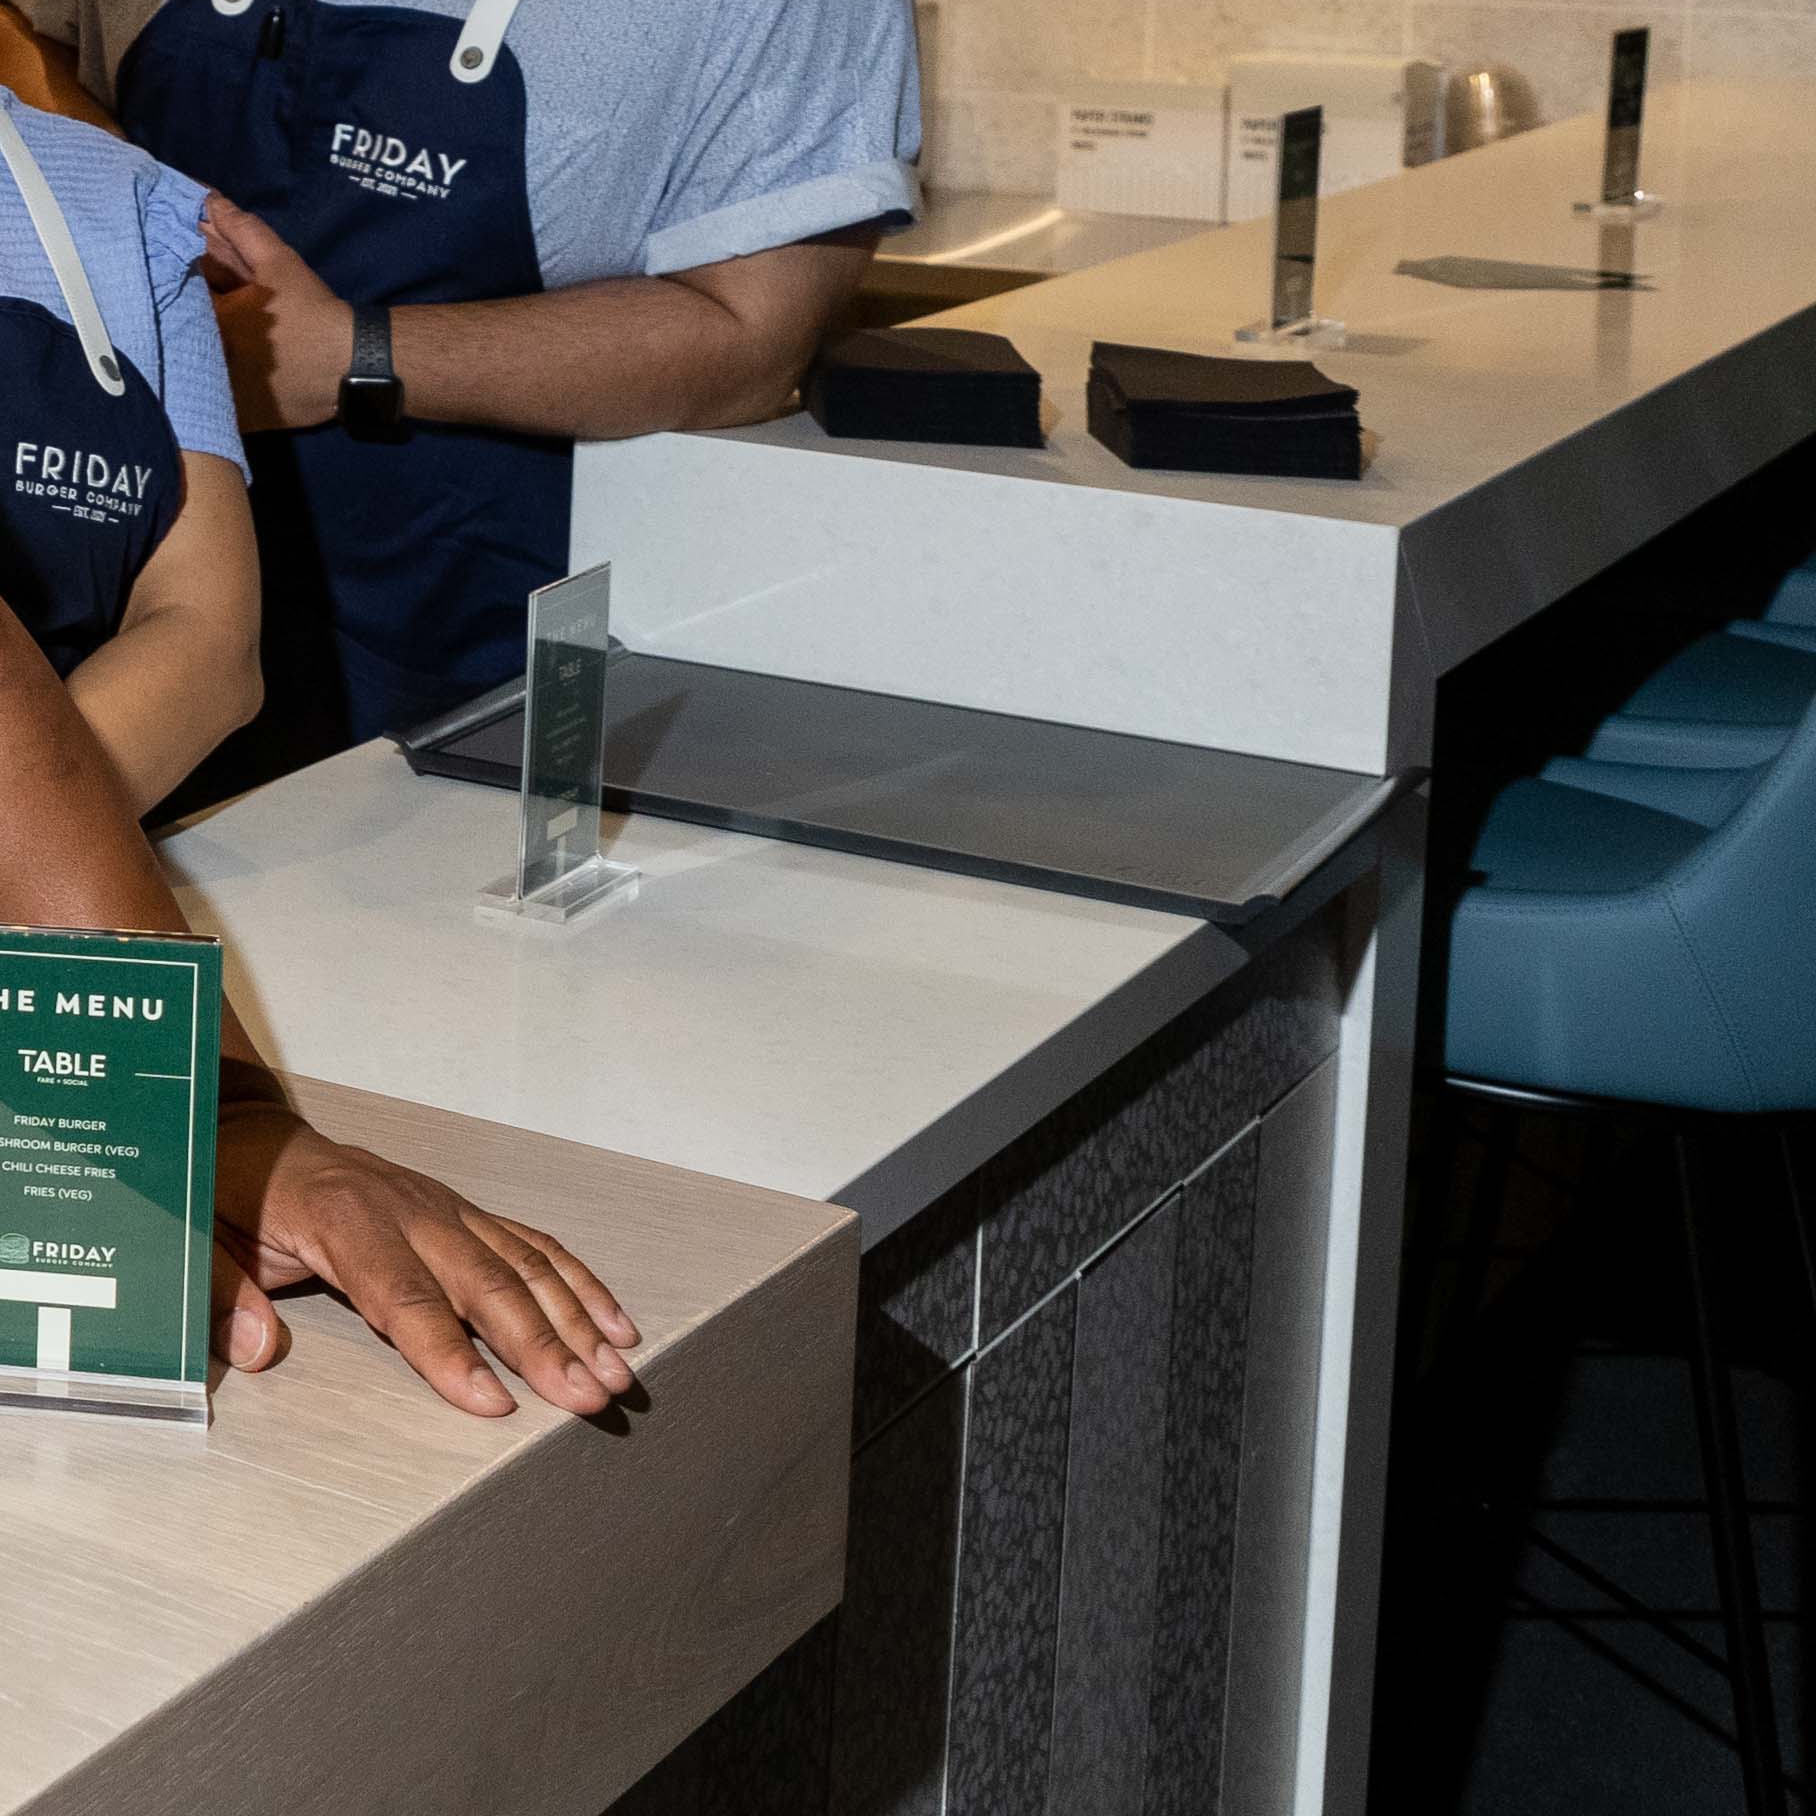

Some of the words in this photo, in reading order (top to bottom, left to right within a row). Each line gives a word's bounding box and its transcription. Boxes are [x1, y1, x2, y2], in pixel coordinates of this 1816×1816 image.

[331, 123, 467, 185] FRIDAY
[375, 167, 451, 199] COMPANY
[16, 442, 152, 499] FRIDAY
[15, 480, 78, 500] BURGER
[86, 491, 143, 516] COMPANY
[56, 992, 164, 1021] MENU
[18, 1049, 106, 1077] TABLE
[14, 1115, 56, 1127] FRIDAY
[58, 1118, 106, 1131] BURGER
[54, 1141, 101, 1154] BURGER
[105, 1145, 139, 1158] (VEG)
[2, 1161, 33, 1172] CHILI
[35, 1163, 81, 1176] CHEESE
[84, 1167, 116, 1179] FRIES
[23, 1186, 55, 1197] FRIES
[58, 1188, 92, 1201] (VEG)
[33, 1241, 116, 1262] FRIDAY
